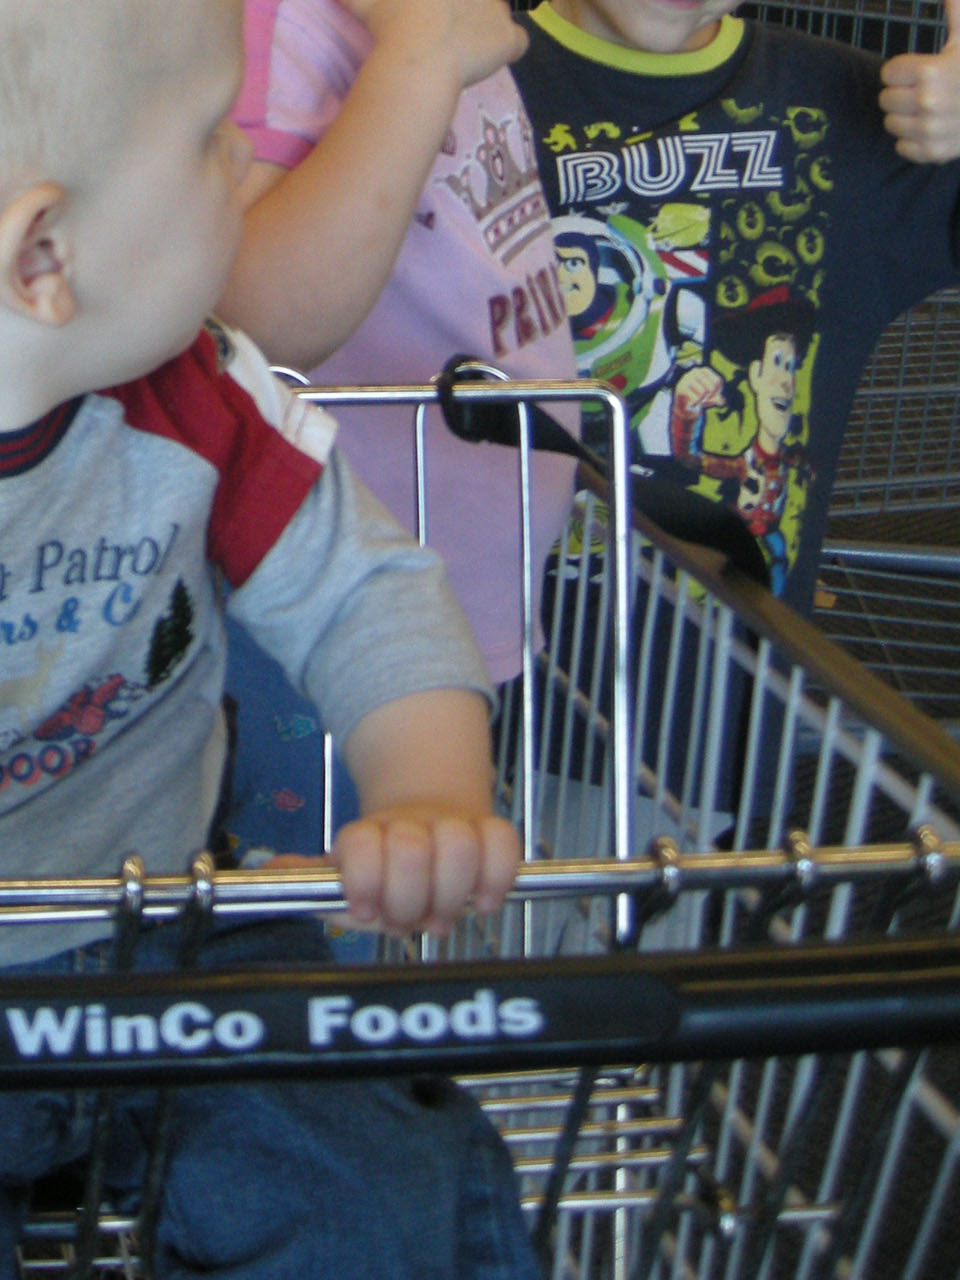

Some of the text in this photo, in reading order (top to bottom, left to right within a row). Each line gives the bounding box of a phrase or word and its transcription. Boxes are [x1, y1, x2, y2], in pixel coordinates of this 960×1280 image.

[556, 130, 783, 205] BUZZ
[28, 522, 180, 595] Patrol
[55, 596, 81, 634] &
[5, 989, 543, 1057] WinCo Foods
